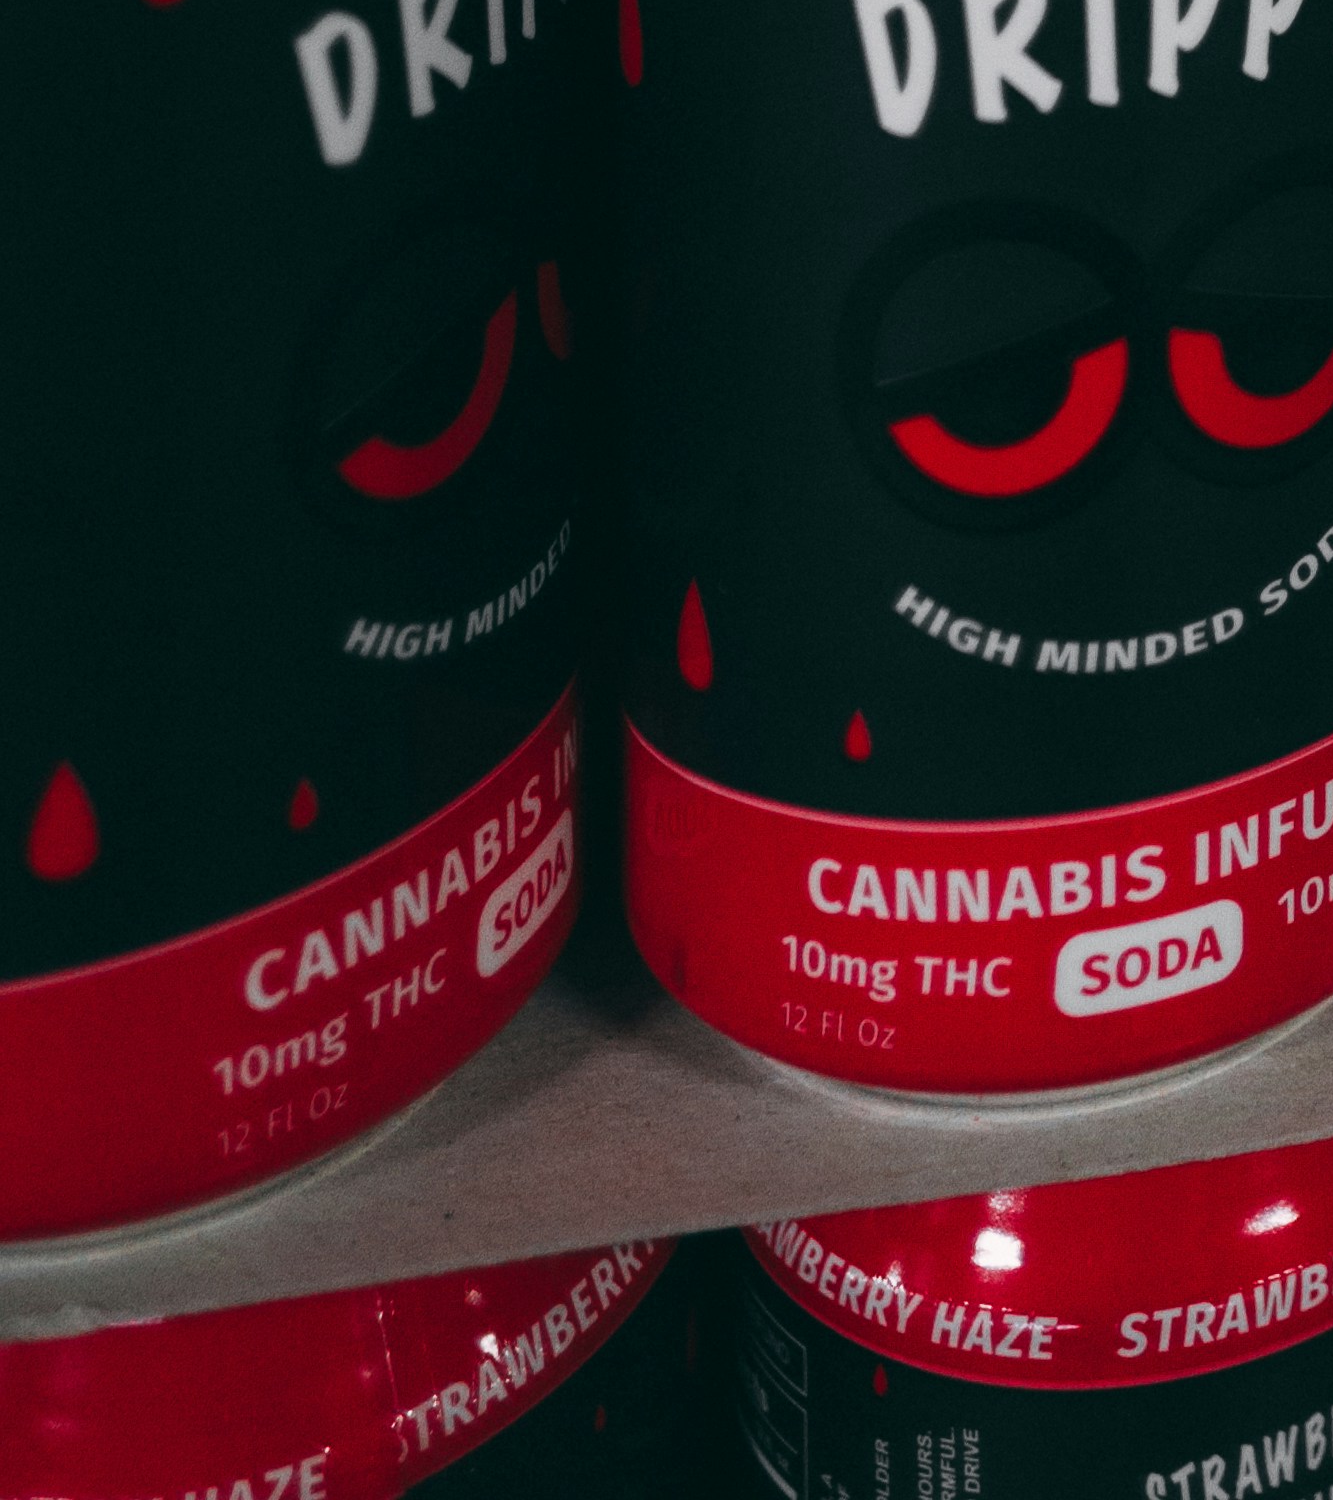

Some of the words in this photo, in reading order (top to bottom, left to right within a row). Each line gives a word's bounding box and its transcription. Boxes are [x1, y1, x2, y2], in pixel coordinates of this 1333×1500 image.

[344, 616, 453, 661] HIGH
[463, 518, 573, 647] MINDED
[893, 584, 1023, 668] HIGH
[1035, 607, 1245, 675] MINDED
[242, 774, 543, 1014] CANNABIS
[806, 844, 1169, 924] CANNABIS
[211, 1018, 348, 1096] 10mg
[363, 948, 449, 1032] THC
[488, 842, 570, 953] SODA
[780, 933, 899, 1004] 10mg
[915, 955, 1013, 998] THC
[1080, 926, 1225, 996] SODA
[782, 1001, 811, 1033] 12
[858, 1017, 898, 1050] Oz
[932, 1306, 1059, 1362] HAZE
